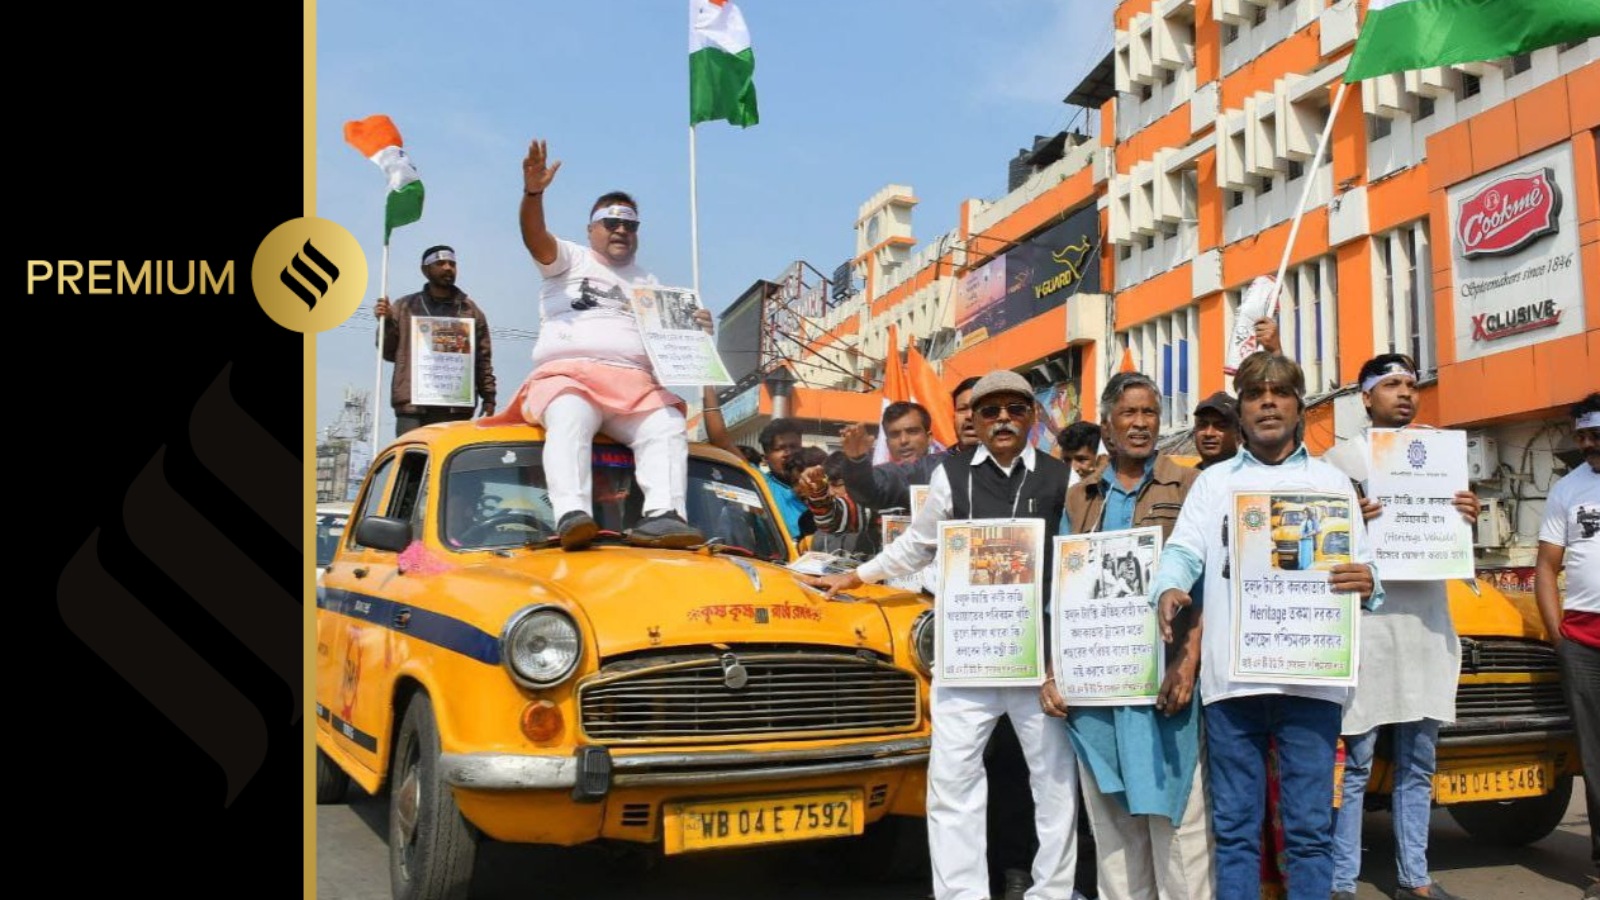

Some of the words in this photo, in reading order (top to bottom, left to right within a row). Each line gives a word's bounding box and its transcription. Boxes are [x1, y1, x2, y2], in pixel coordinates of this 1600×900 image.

[1522, 265, 1546, 281] since
[1547, 252, 1574, 274] 1846
[1034, 269, 1073, 299] V-GUARD
[1472, 299, 1556, 341] XCLUSIVE
[1249, 605, 1287, 624] Heritage
[1450, 773, 1467, 794] WB
[1472, 771, 1490, 792] 04
[1495, 770, 1503, 792] E
[701, 810, 729, 839] WB
[738, 808, 766, 835] 04
[773, 806, 785, 833] E
[793, 801, 849, 831] 7592
